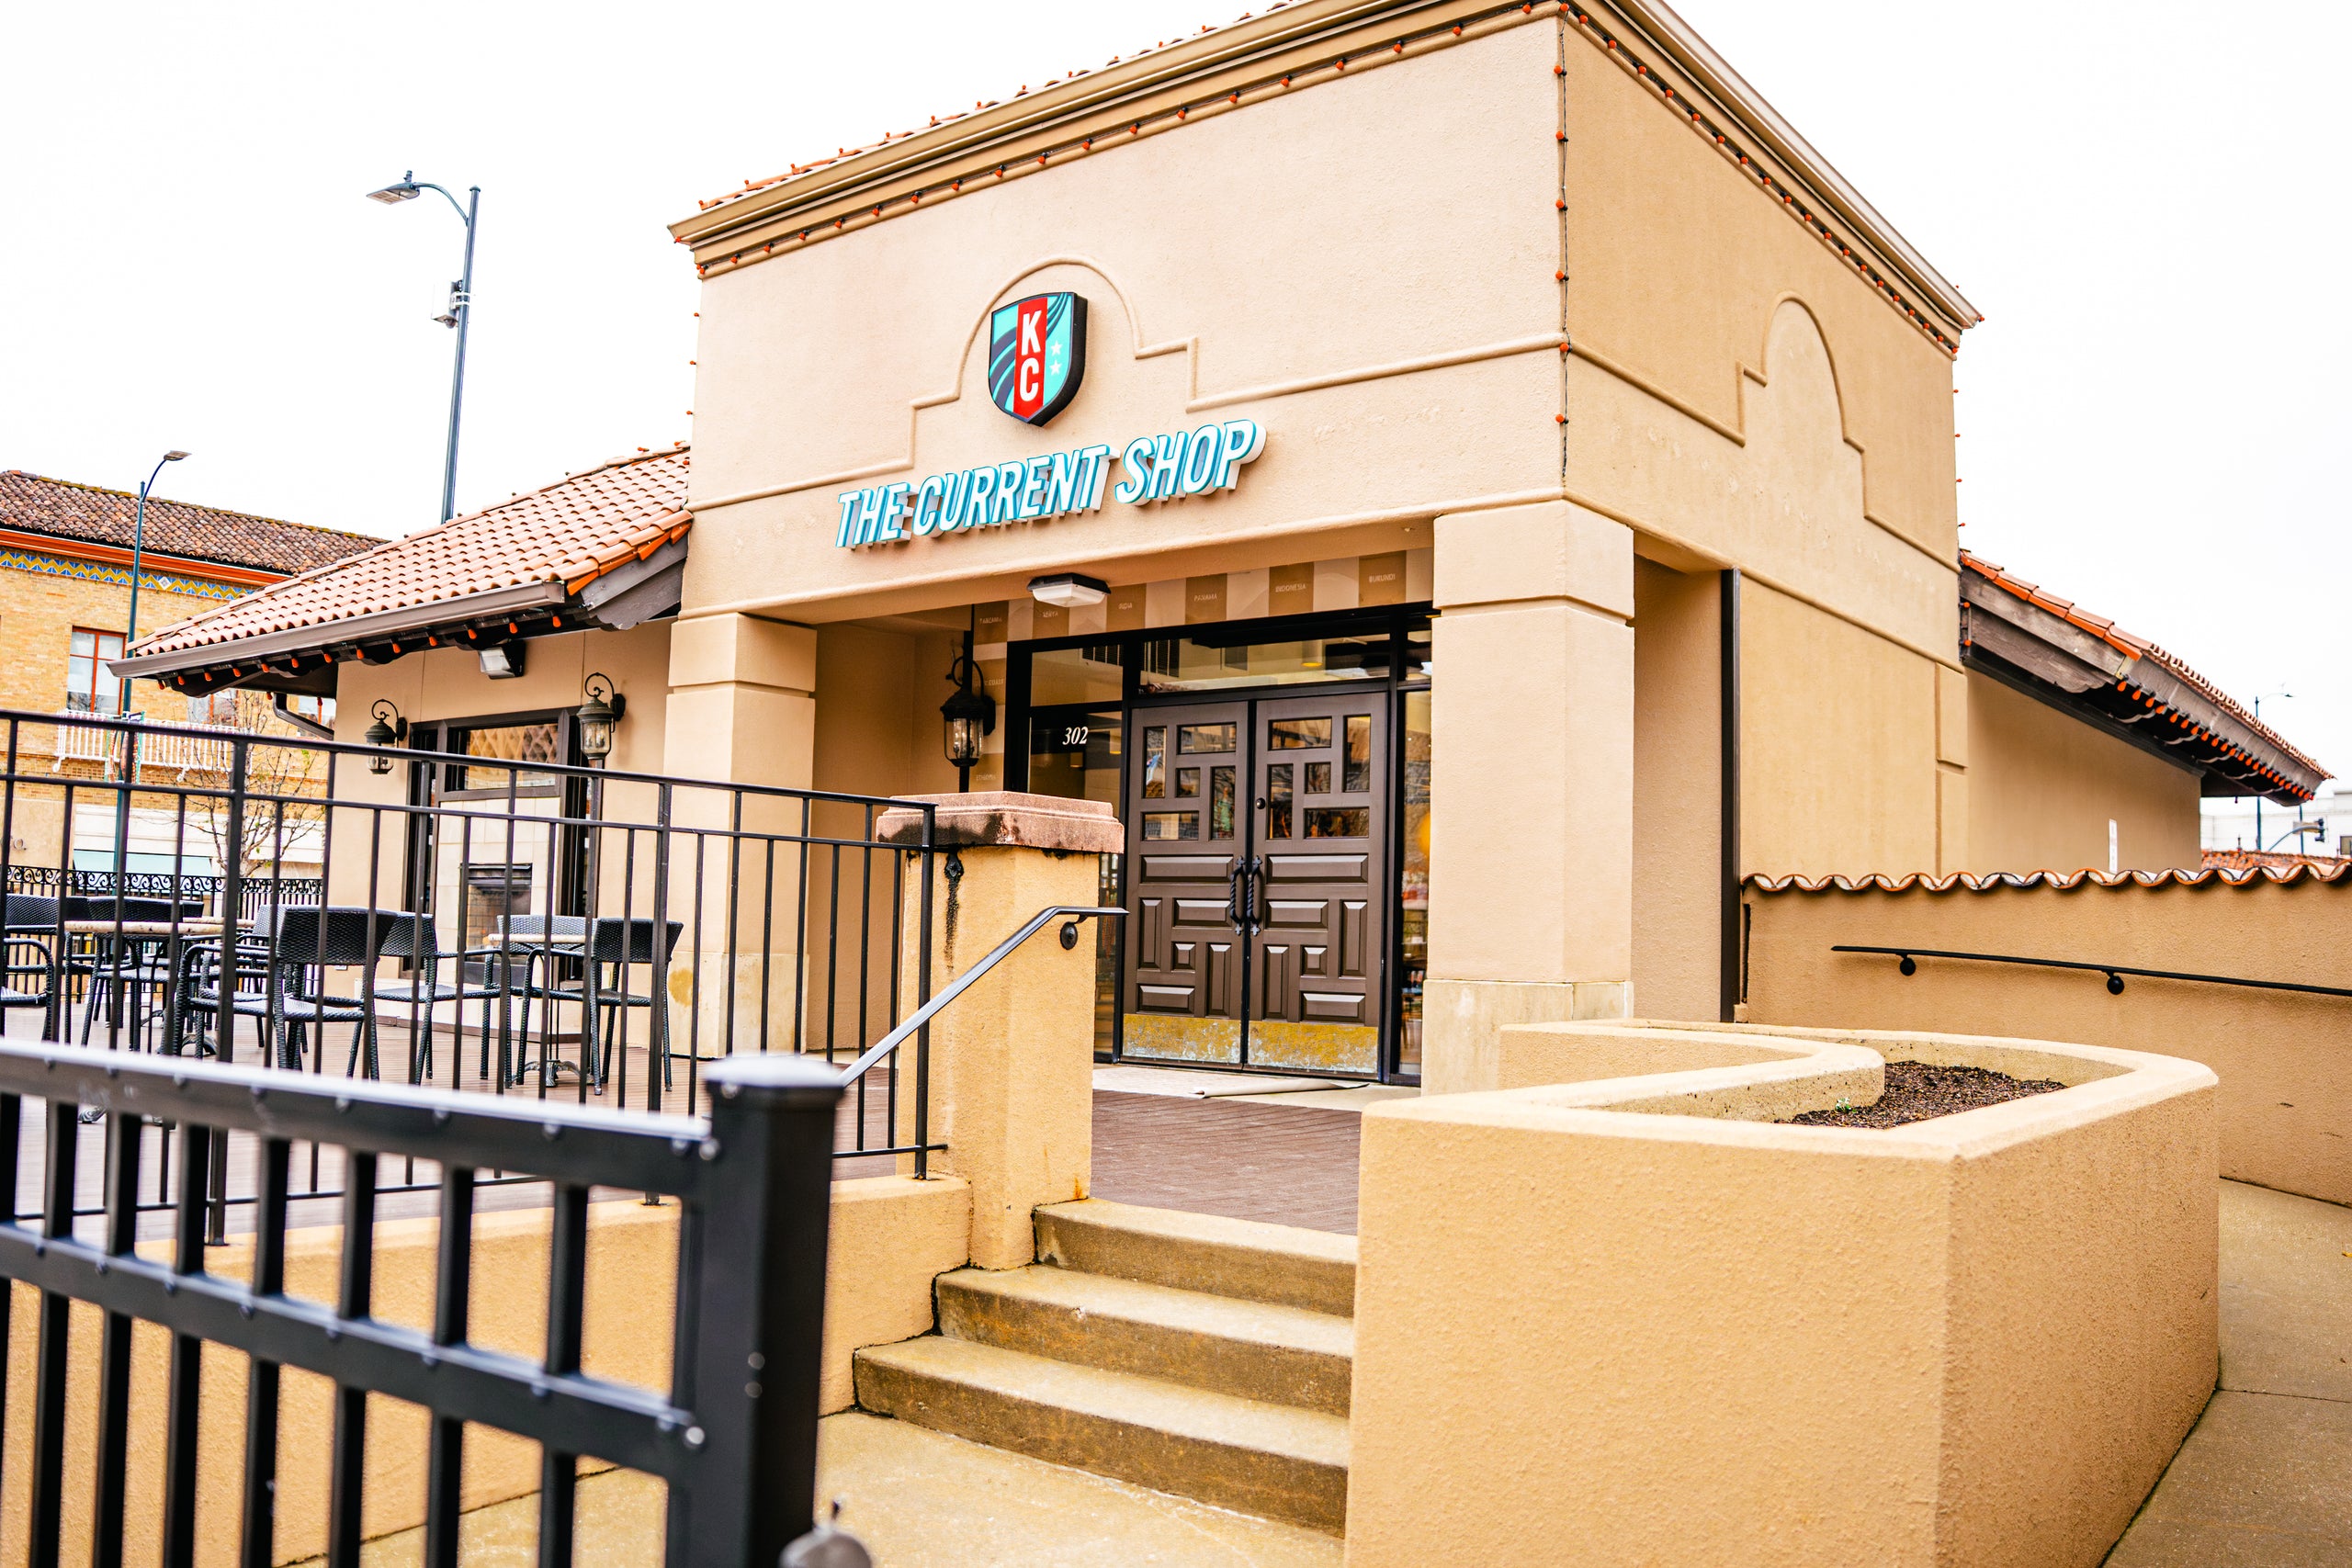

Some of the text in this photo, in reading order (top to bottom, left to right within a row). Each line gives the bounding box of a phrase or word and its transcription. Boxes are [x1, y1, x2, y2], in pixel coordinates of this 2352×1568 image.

[835, 419, 1265, 549] THE CURRENT SHOP
[1275, 582, 1306, 593] INDONESIA
[1062, 726, 1089, 746] 302
